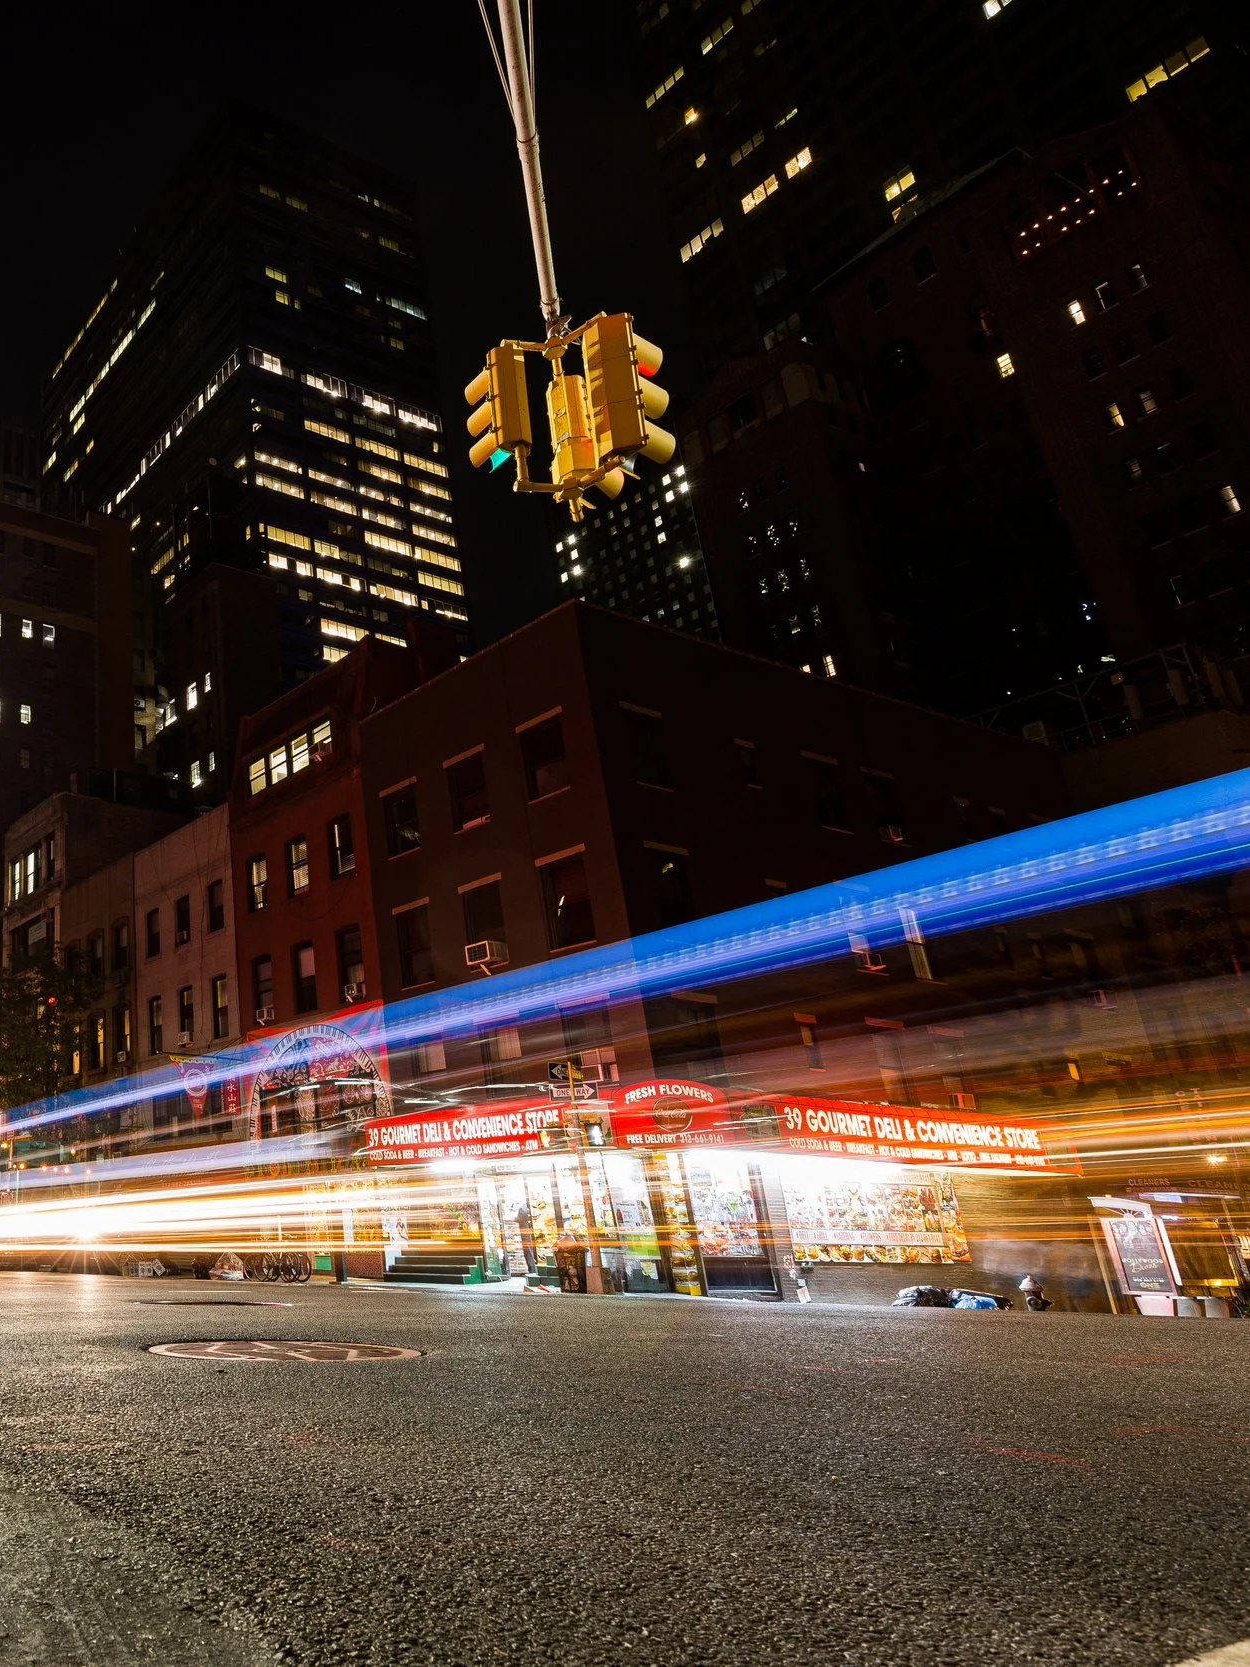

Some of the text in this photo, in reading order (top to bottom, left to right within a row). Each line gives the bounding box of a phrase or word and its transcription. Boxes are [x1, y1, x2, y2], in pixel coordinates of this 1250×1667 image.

[556, 1088, 590, 1097] ONE WAY
[625, 1084, 715, 1105] FRESH FLOWERS
[368, 1128, 379, 1147] 39
[380, 1124, 422, 1147] GOURMET
[423, 1121, 442, 1144] DELI
[443, 1119, 451, 1142] &
[452, 1113, 524, 1140] CONVENIENCE
[783, 1106, 1041, 1150] 39 GOURMET DELI & CONVENIENCE STORE
[626, 1134, 725, 1144] FREE DELIVERY 212-661-9141
[369, 1151, 383, 1161] COLD
[383, 1150, 397, 1160] SODA
[403, 1148, 414, 1160] BEER
[418, 1147, 445, 1158] BREAKFAST
[448, 1146, 459, 1157] HOT
[467, 1144, 482, 1155] COLD
[483, 1141, 521, 1154] SANDWICHES
